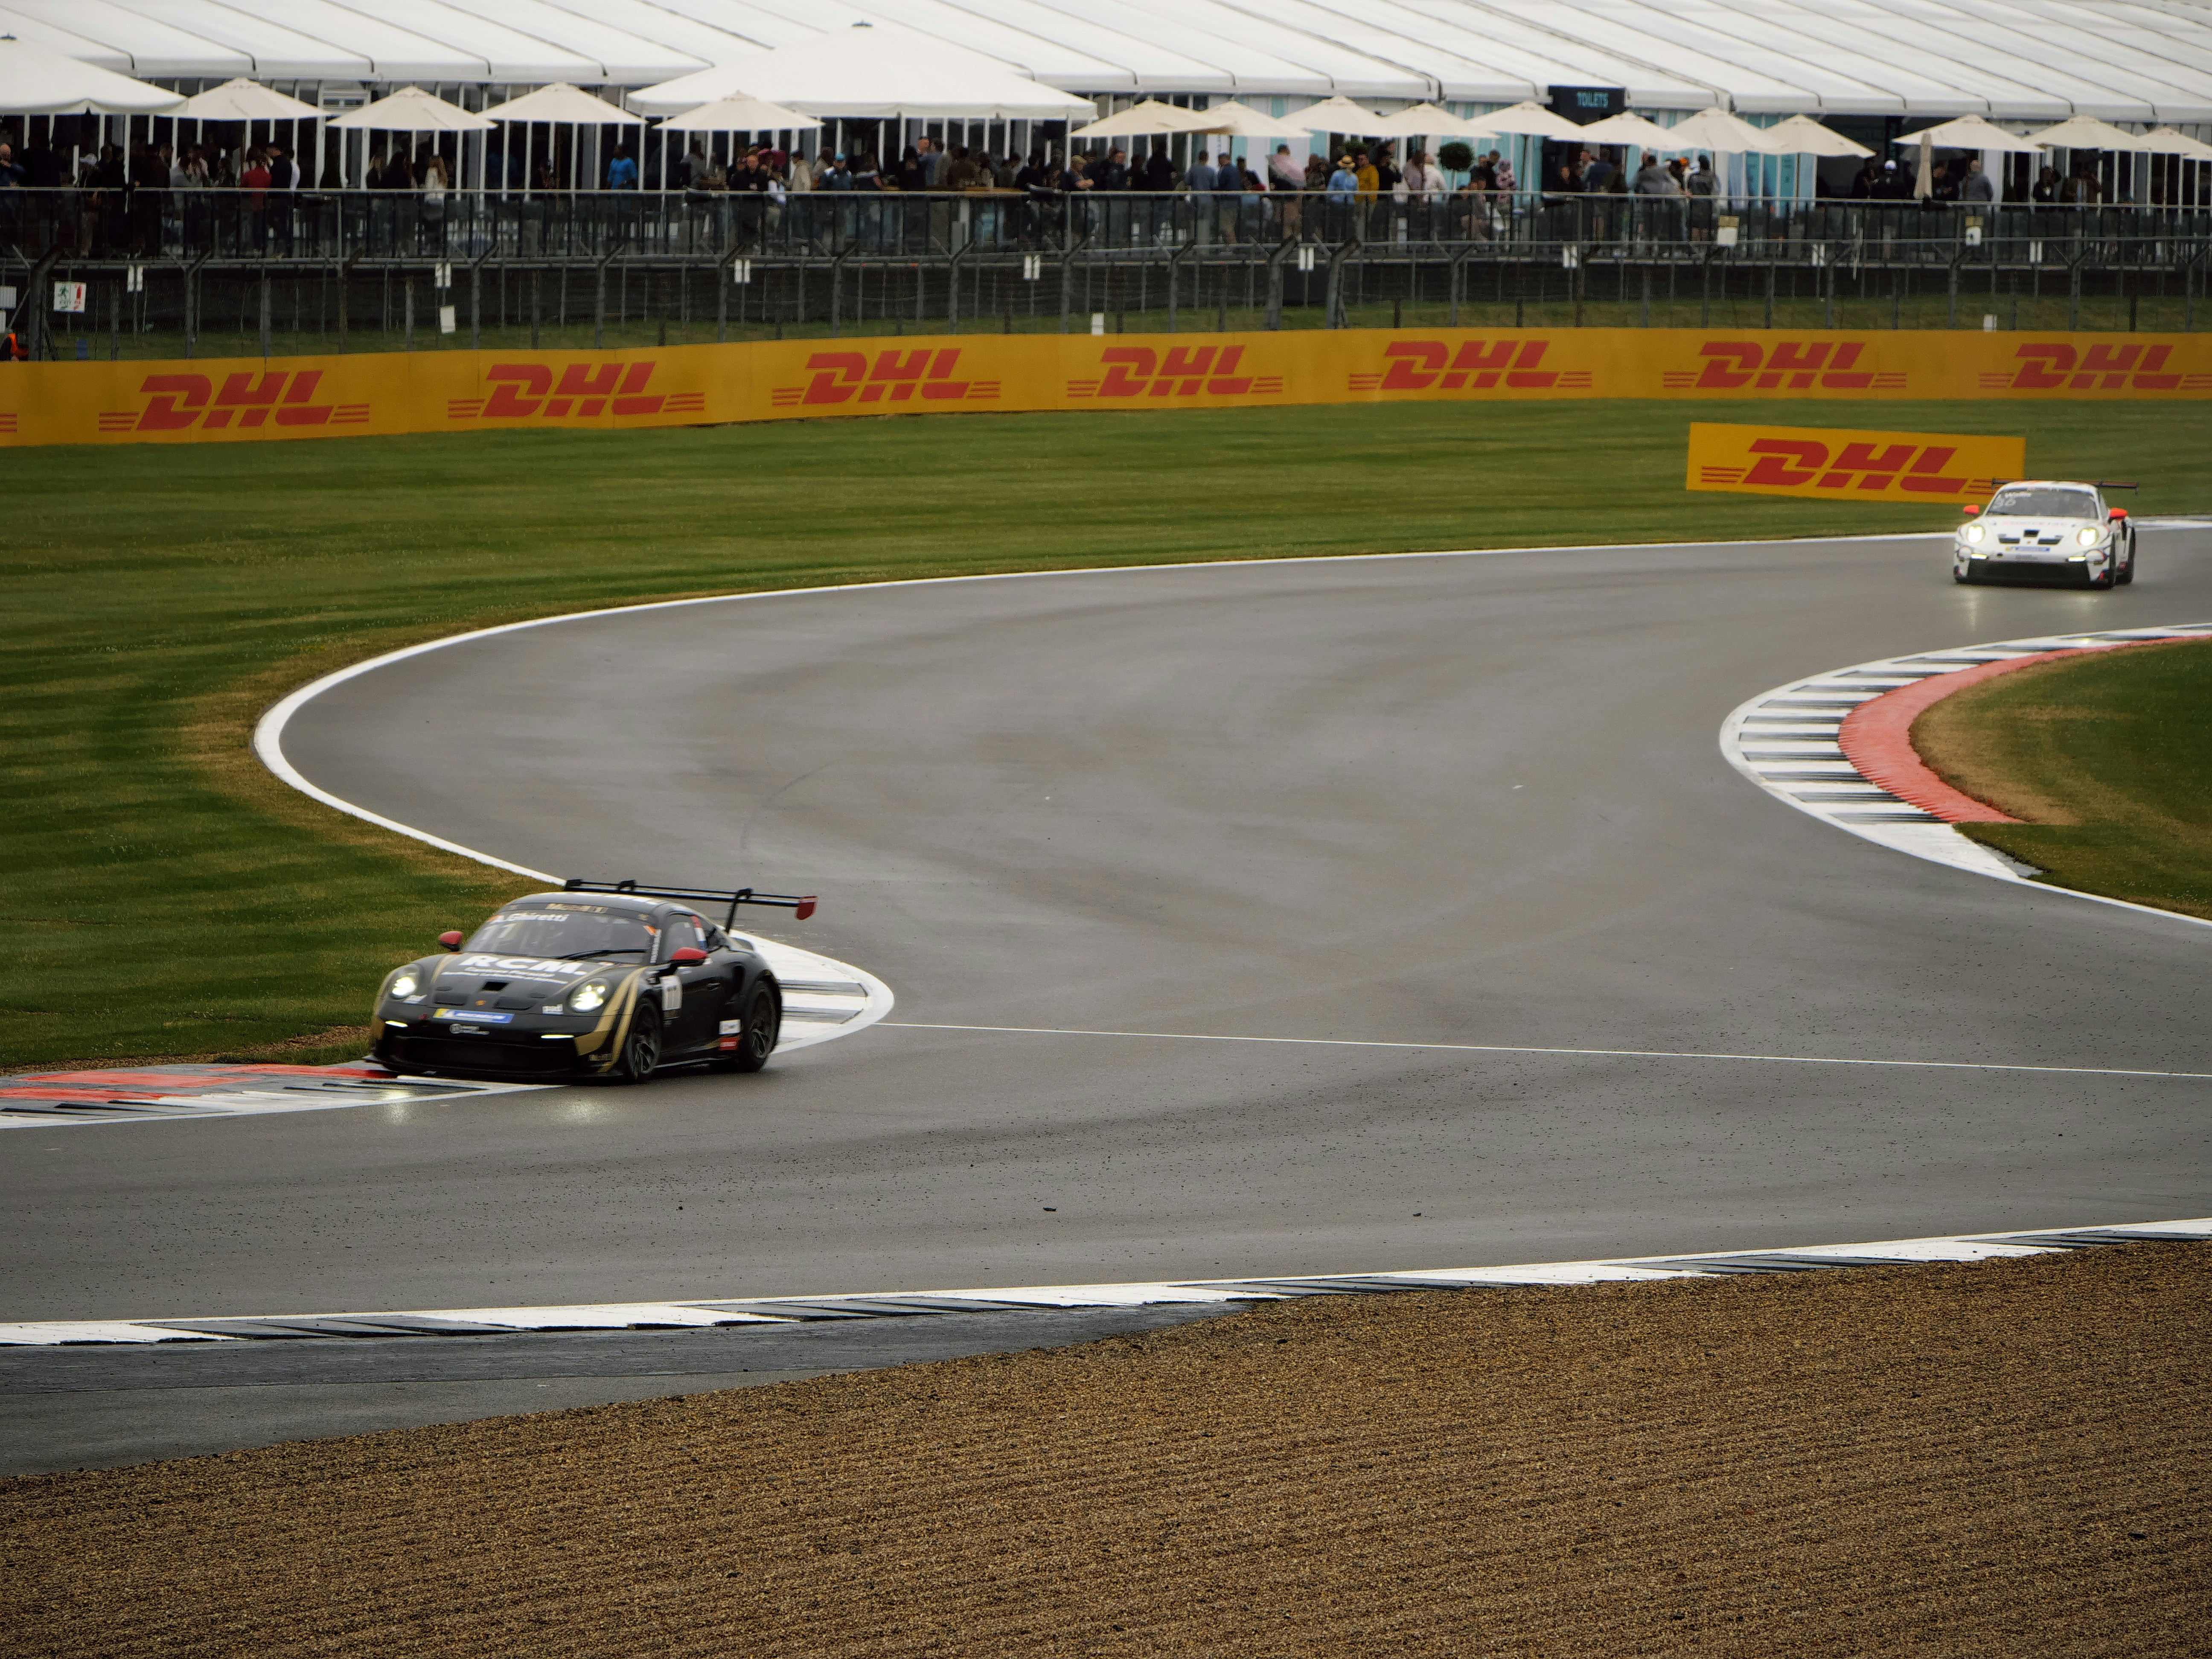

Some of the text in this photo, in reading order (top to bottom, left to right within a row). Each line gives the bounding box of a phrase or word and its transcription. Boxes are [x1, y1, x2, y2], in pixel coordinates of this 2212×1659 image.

[1577, 91, 1608, 108] TOILETS
[804, 349, 969, 404] DHL
[1100, 347, 1252, 396] DHL
[1382, 341, 1559, 389] DHL
[1697, 342, 1873, 388] DHL
[2012, 344, 2181, 389] DHL
[137, 370, 334, 431] DHL
[483, 363, 666, 417] DHL
[1742, 439, 1967, 493] DHL
